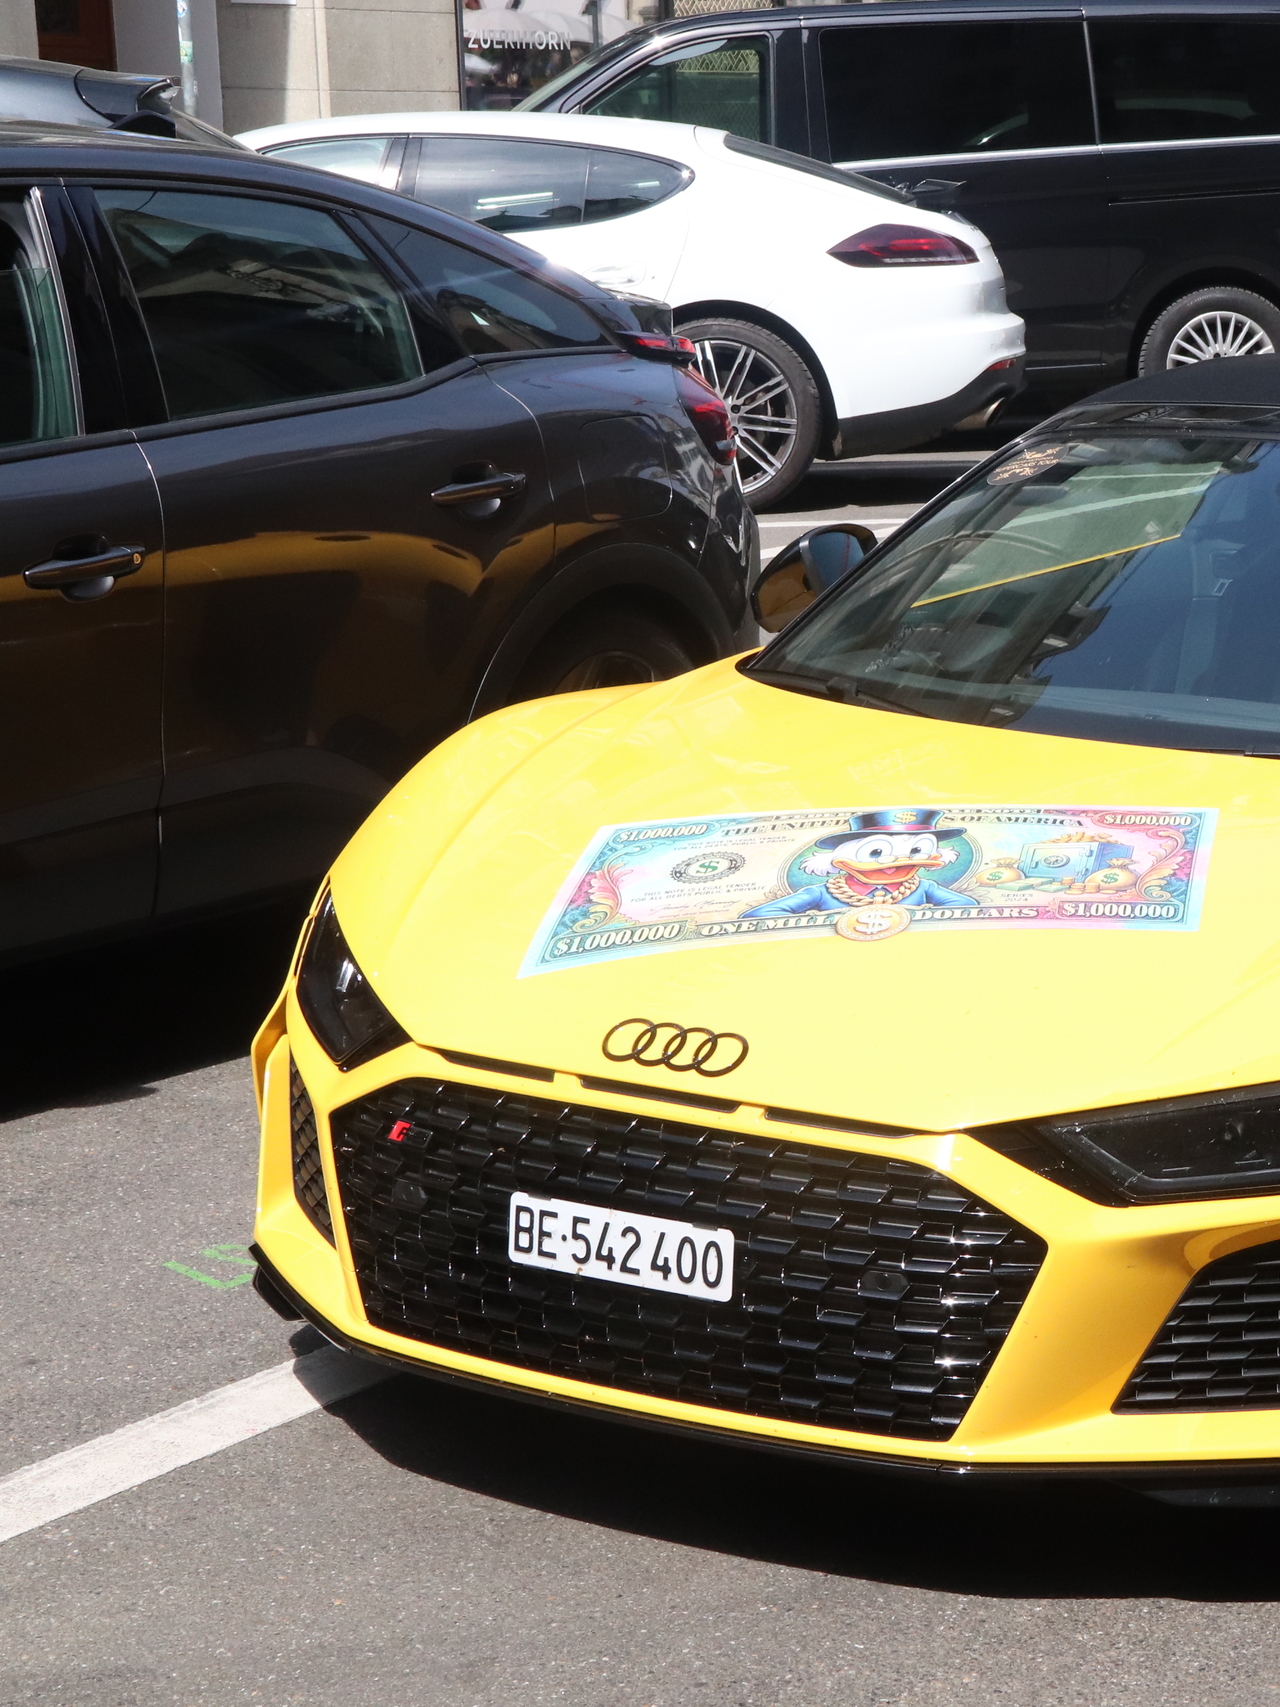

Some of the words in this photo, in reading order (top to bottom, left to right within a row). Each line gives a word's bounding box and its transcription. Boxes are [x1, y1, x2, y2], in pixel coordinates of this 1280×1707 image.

[959, 815, 988, 824] OF
[989, 815, 1089, 829] AMERICA
[1103, 812, 1192, 827] $1,000,000
[617, 824, 708, 844] $1,000,000
[720, 825, 765, 838] THE
[1062, 902, 1176, 919] $1,000,000
[700, 920, 758, 936] ONE
[913, 907, 1039, 920] DOLLARS
[554, 923, 681, 956] $1,000,000
